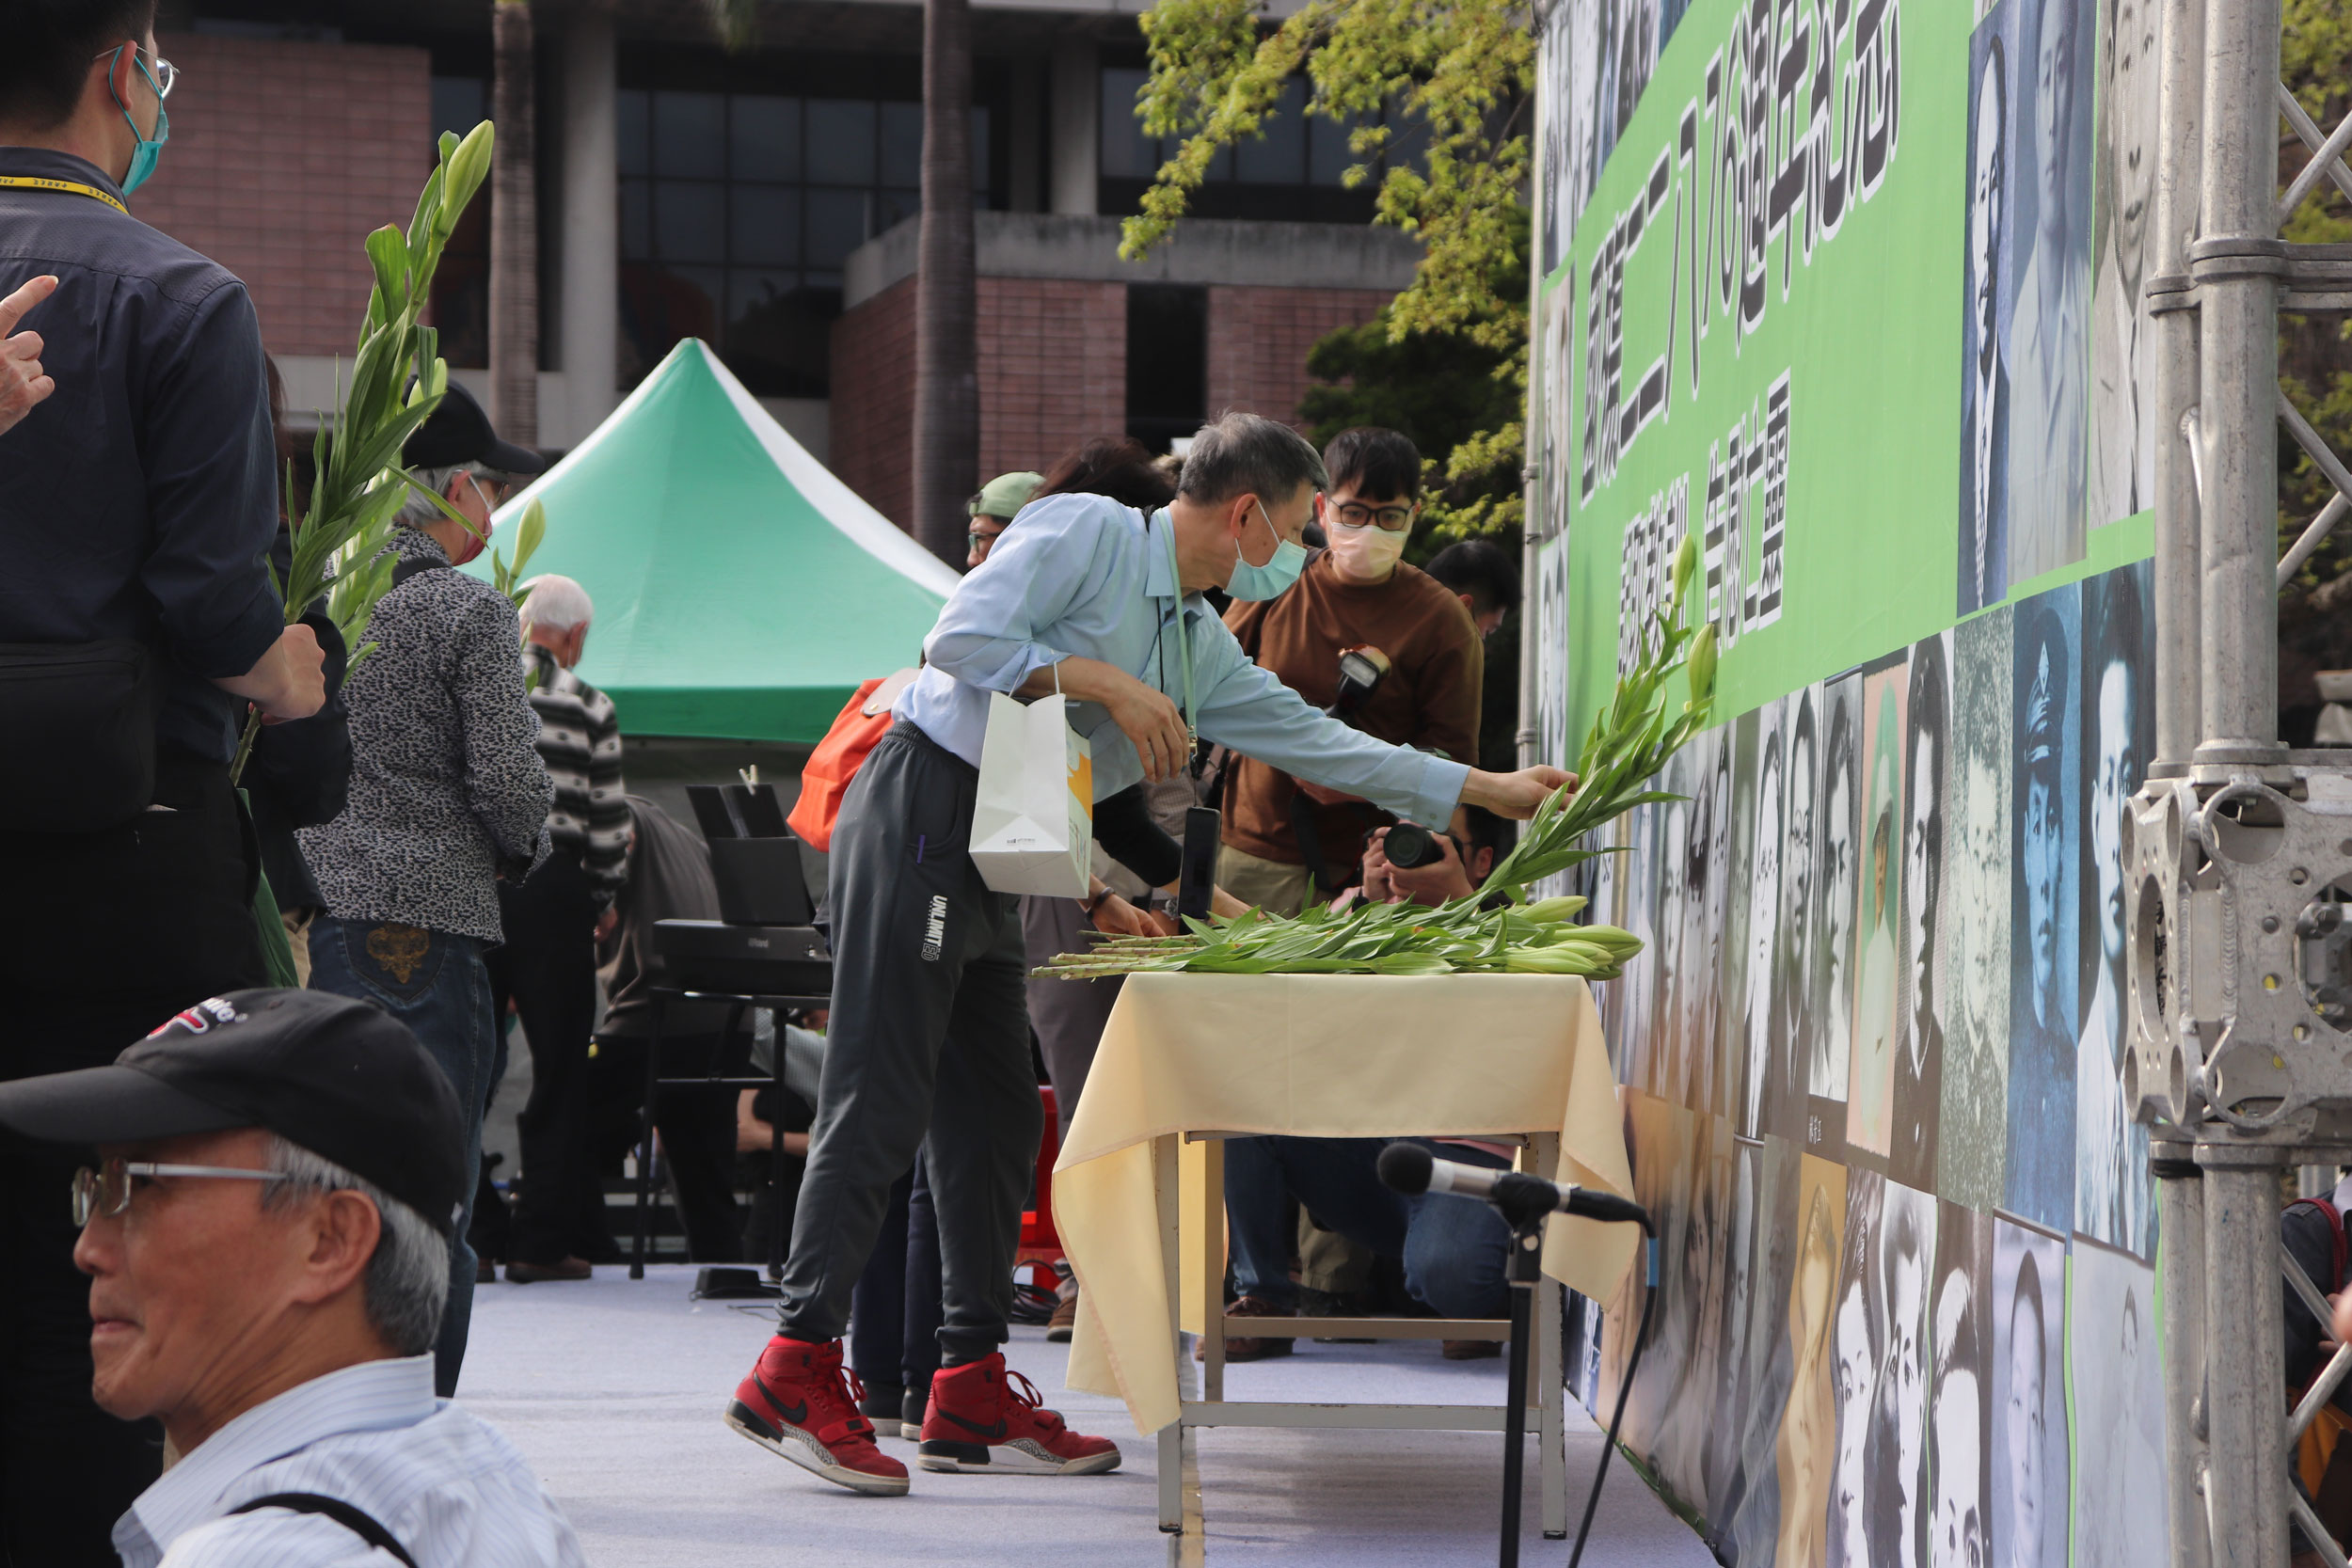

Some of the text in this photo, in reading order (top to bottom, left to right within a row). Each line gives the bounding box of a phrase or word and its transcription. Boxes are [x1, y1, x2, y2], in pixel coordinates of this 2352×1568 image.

[1704, 367, 1791, 657] 告慰亡靈
[921, 895, 948, 961] UNLIMITED
